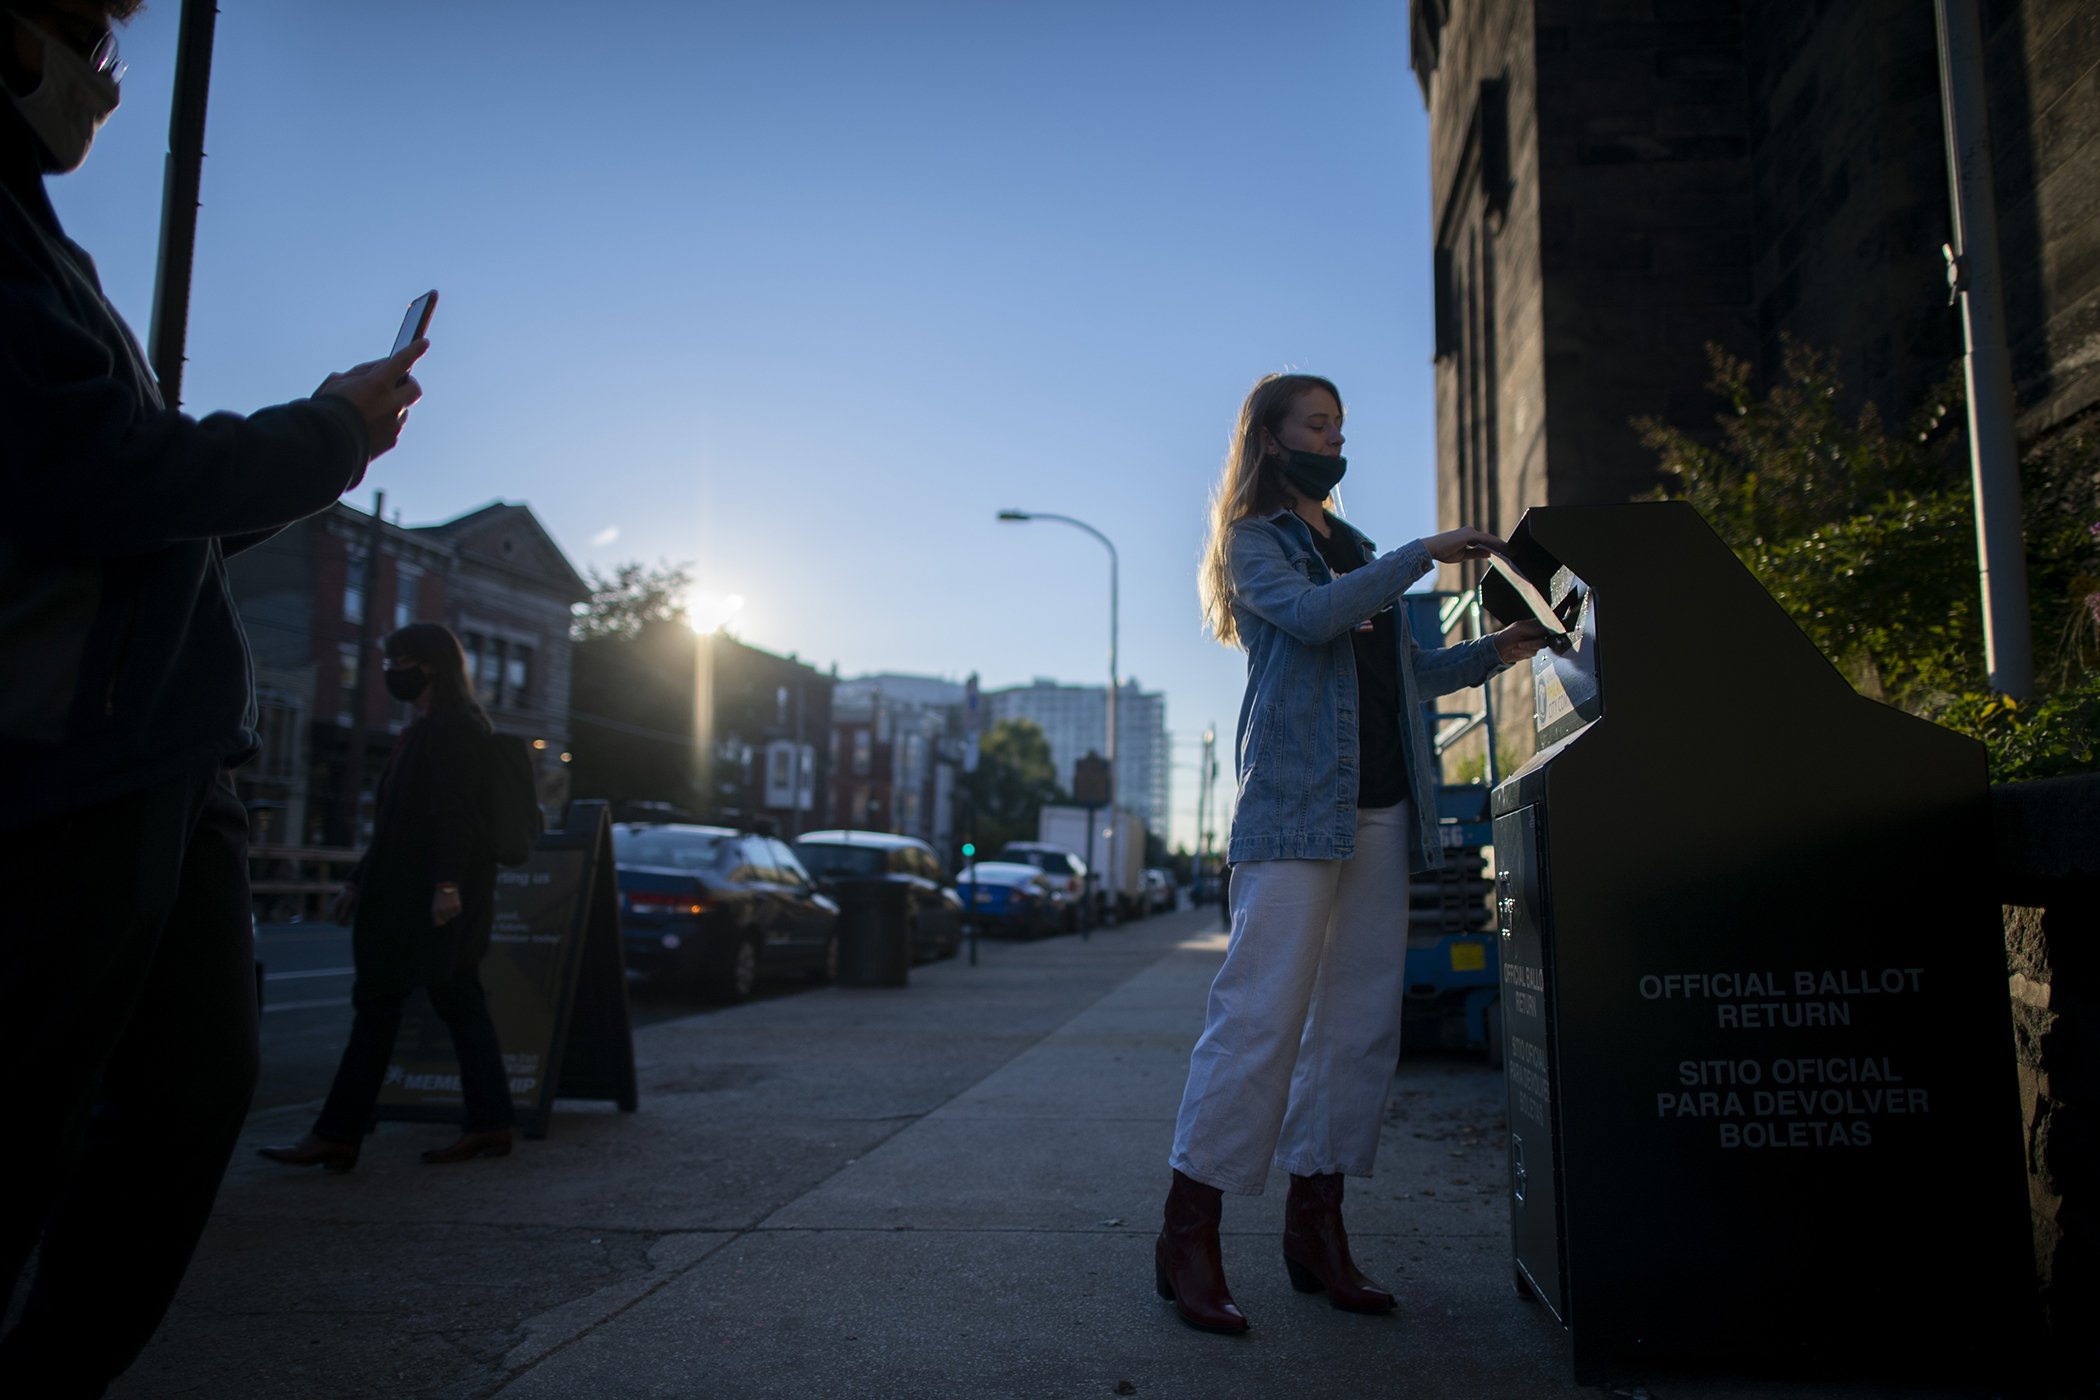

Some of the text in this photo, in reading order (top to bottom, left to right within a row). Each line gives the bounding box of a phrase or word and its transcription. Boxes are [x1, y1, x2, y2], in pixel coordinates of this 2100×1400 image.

[1504, 962, 1545, 993] OFFICIAL BALLO
[1639, 968, 1925, 1000] OFFICIAL BALLOT
[1516, 991, 1537, 1017] RETURN
[1717, 1000, 1853, 1029] RETURN
[1678, 1056, 1904, 1087] SITIO OFICIAL
[1657, 1088, 1931, 1118] PARA DEVOLVER
[1718, 1120, 1873, 1149] BOLETAS
